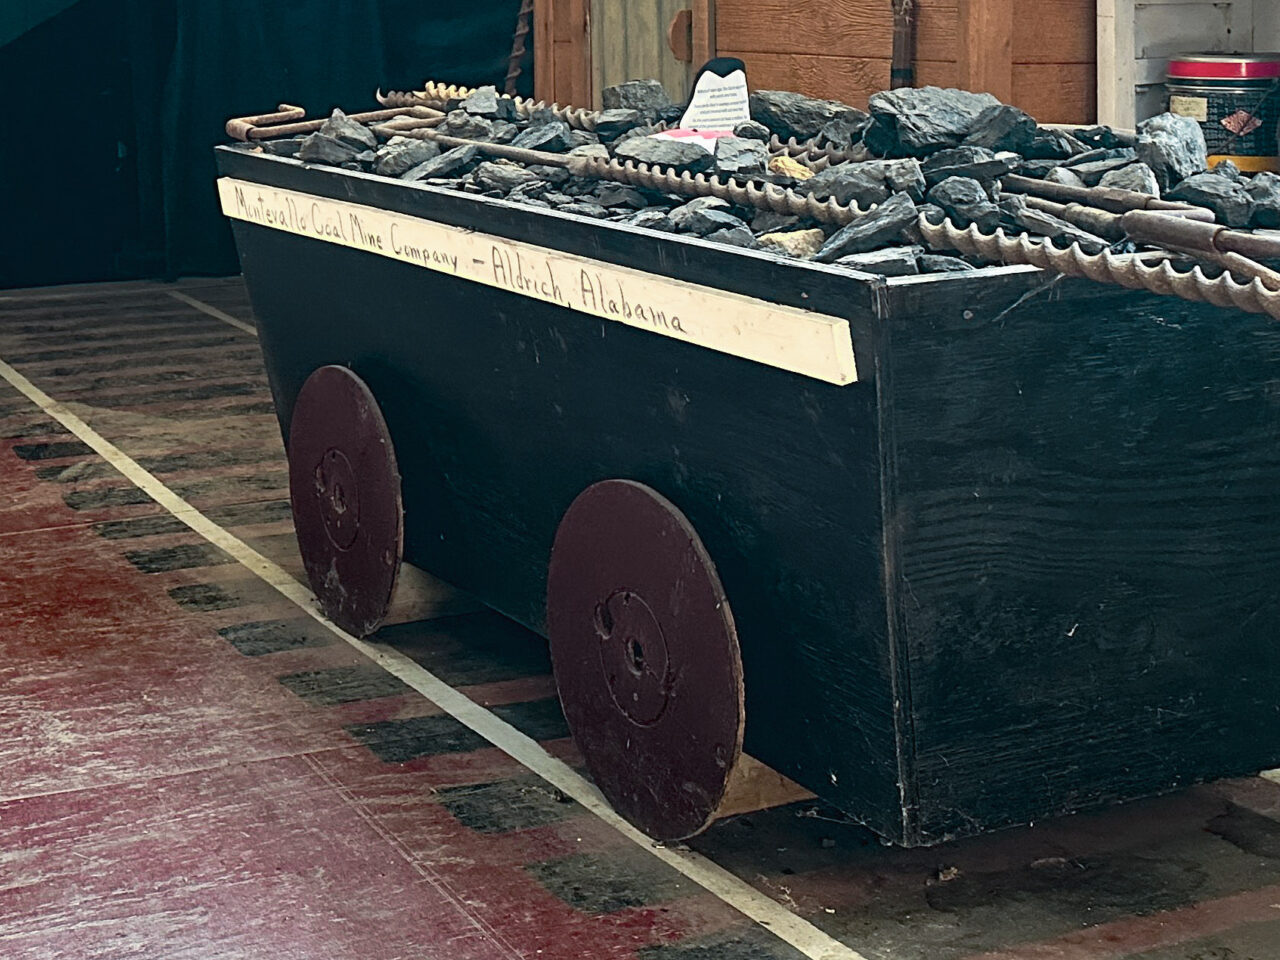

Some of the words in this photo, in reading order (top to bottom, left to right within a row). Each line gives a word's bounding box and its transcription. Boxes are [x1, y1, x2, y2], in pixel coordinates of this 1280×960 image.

[311, 202, 348, 242] Coal
[349, 213, 384, 251] Mine
[390, 223, 458, 273] Company
[580, 268, 688, 335] Alabama
